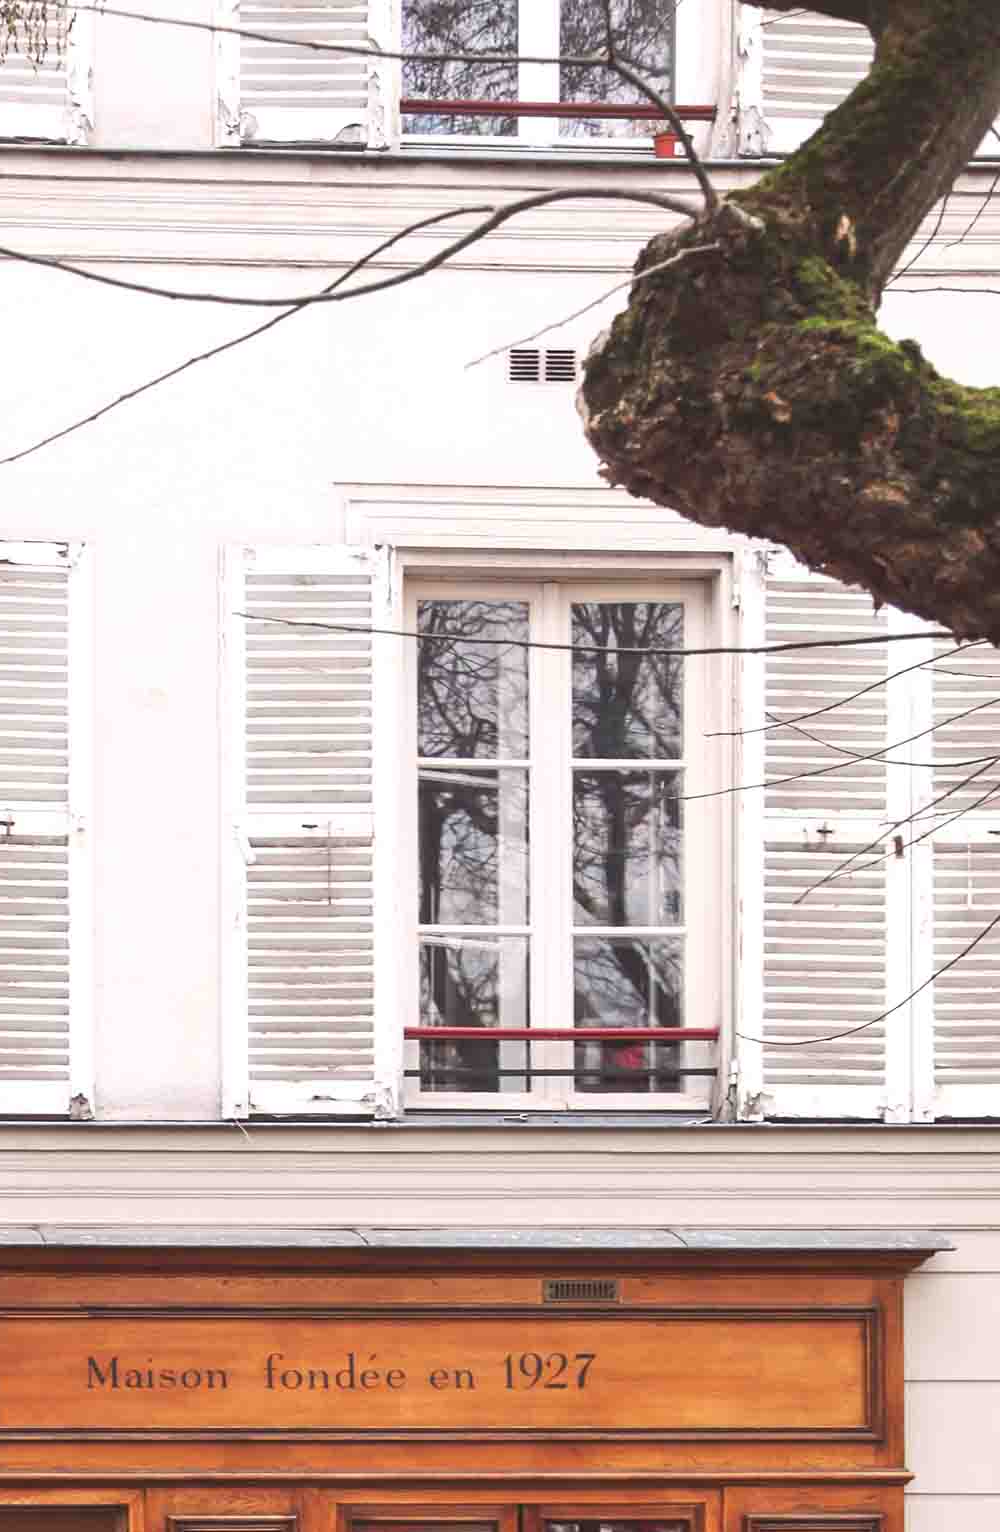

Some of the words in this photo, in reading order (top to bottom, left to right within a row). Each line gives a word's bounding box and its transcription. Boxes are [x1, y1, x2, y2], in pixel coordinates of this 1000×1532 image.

[87, 1354, 232, 1391] Maison
[263, 1351, 408, 1391] fondée
[428, 1365, 476, 1390] en
[503, 1352, 597, 1391] 1927
